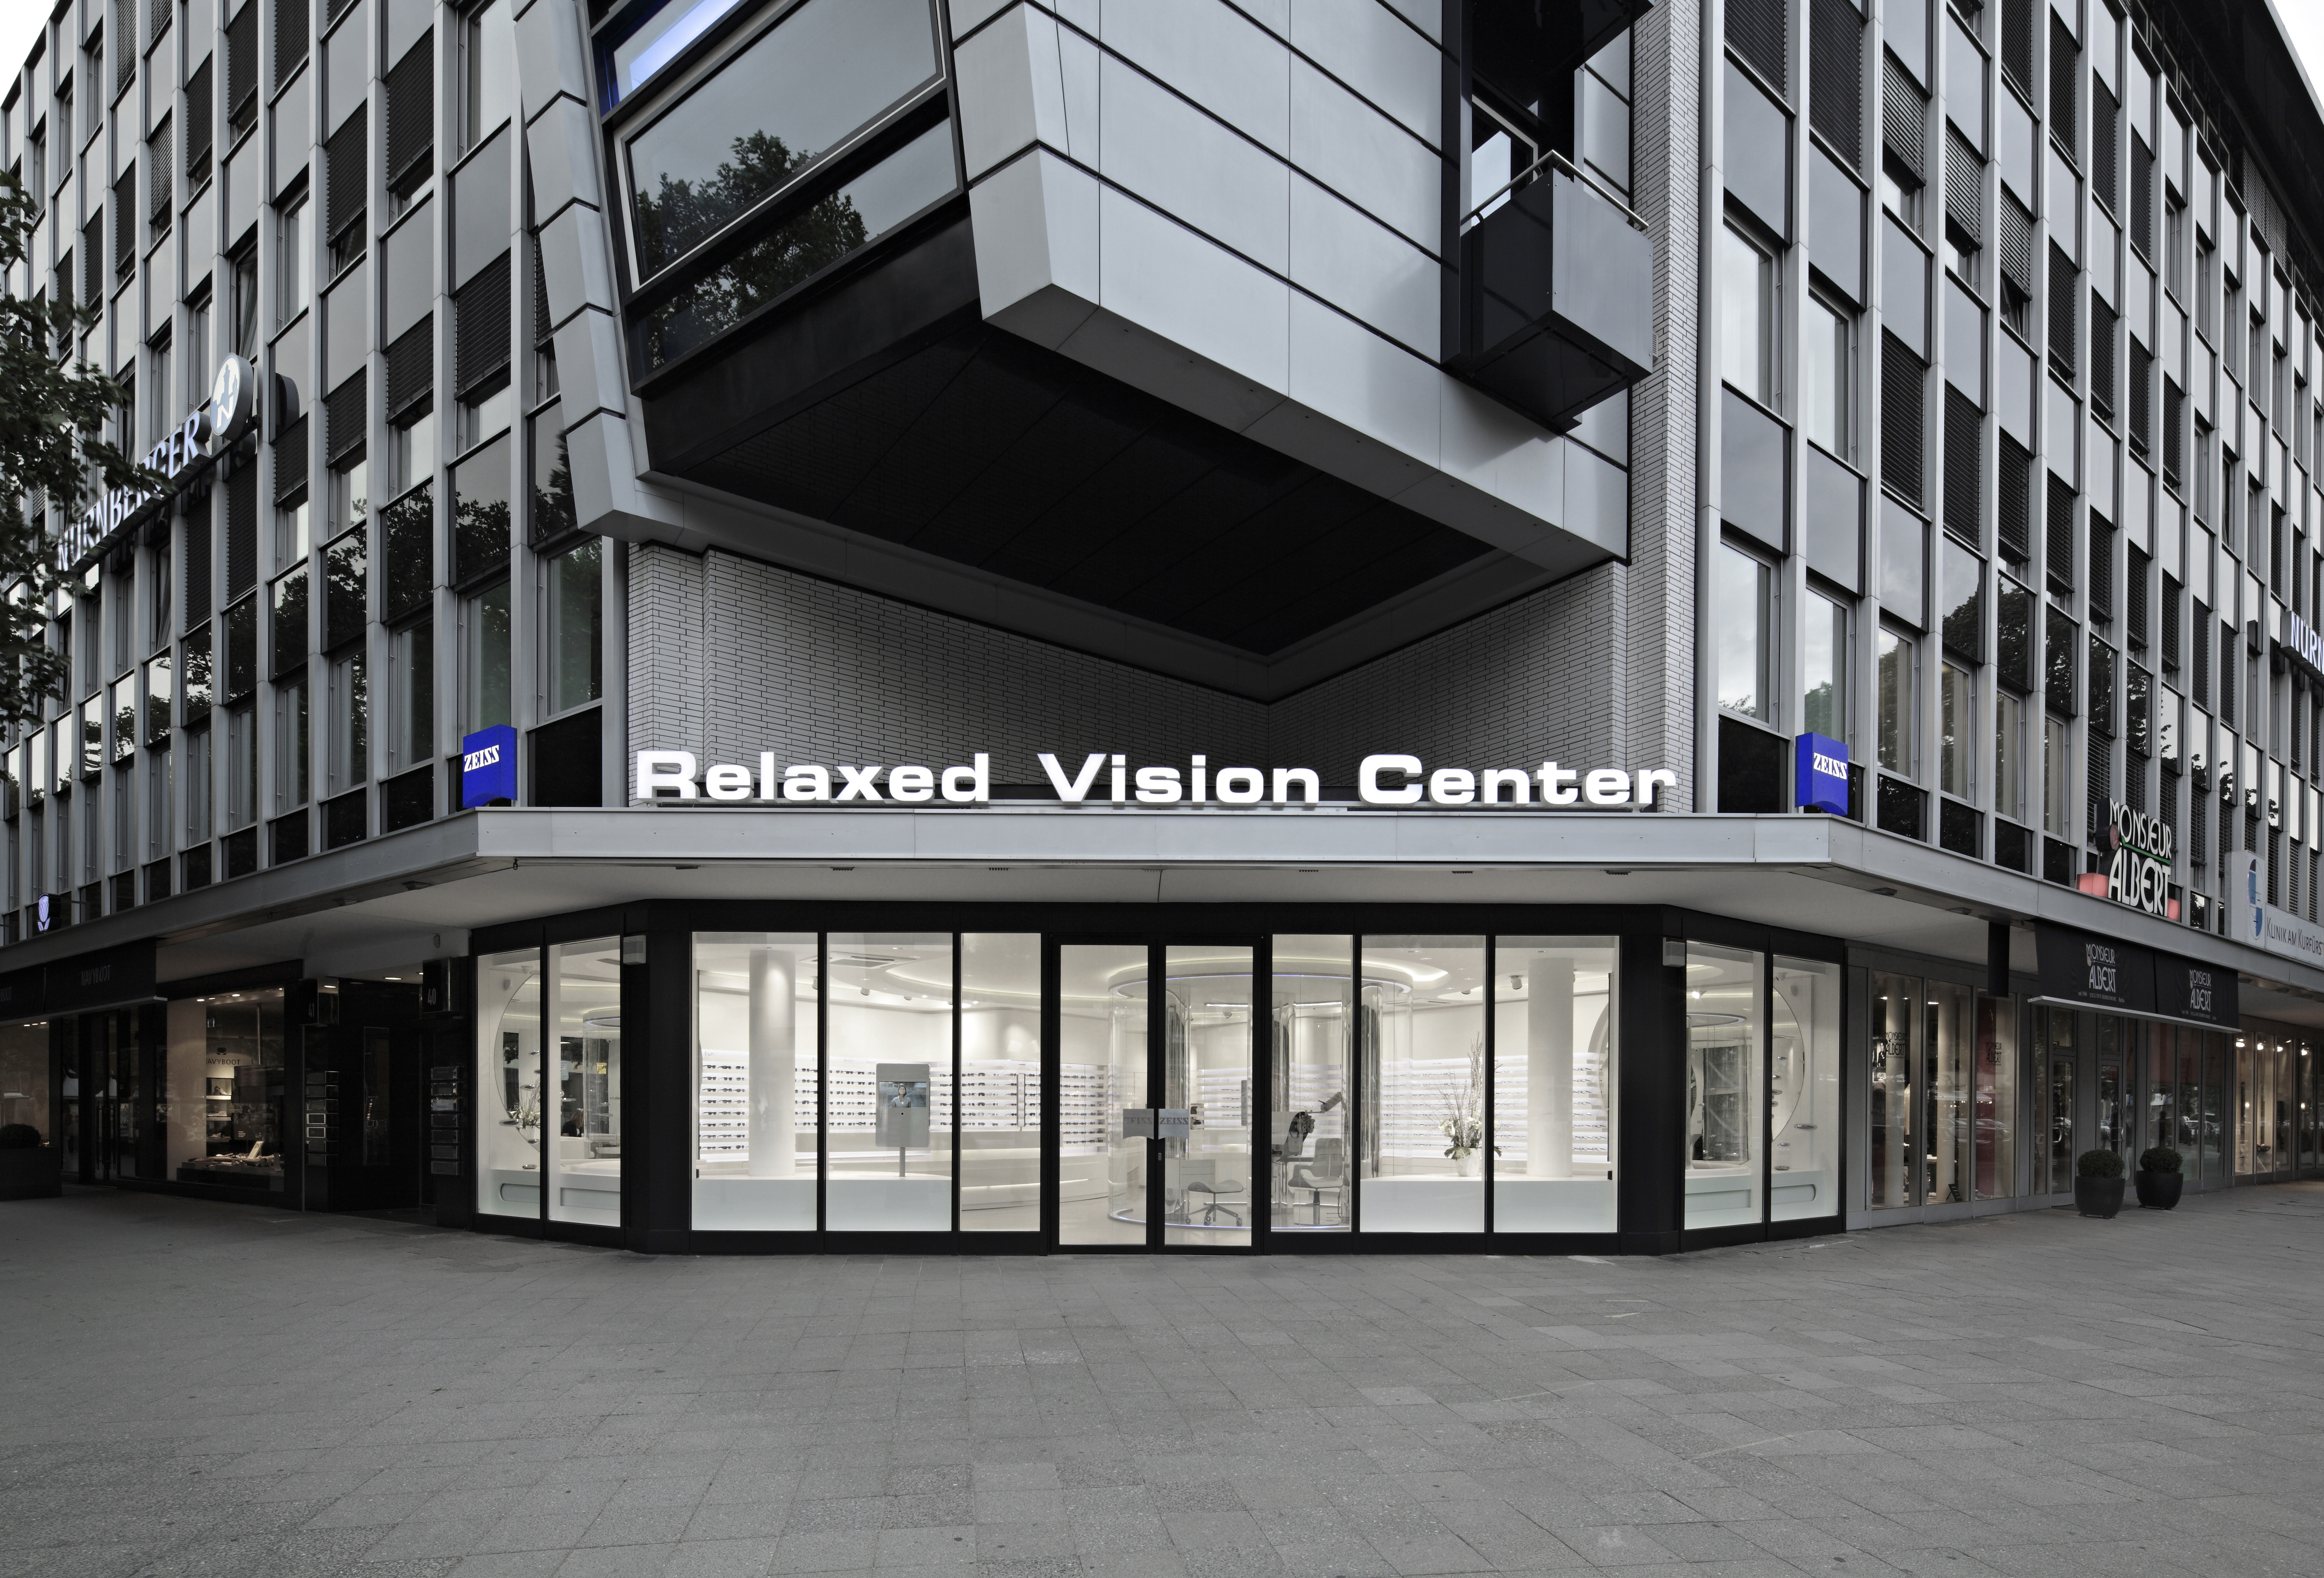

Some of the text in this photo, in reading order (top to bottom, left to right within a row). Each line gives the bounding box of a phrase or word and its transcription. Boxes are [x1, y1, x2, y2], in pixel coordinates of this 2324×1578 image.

[464, 745, 499, 772] ZEISS
[1813, 752, 1847, 780] ZEISS
[637, 750, 1677, 804] Relaxed Vision Center
[2109, 797, 2172, 859] MONSIEUR
[2108, 847, 2172, 917] ALBERT
[2267, 916, 2323, 955] KLINIK AM KURFÜRS
[2086, 943, 2115, 964] MONSIEUR
[81, 965, 111, 987] NAVYBOOT
[2089, 965, 2116, 993] ALBERT
[2189, 969, 2212, 987] MONSIEUR
[427, 988, 437, 1005] 40
[2190, 988, 2212, 1012] ALBERT
[308, 1002, 314, 1018] 41
[1885, 1043, 1905, 1056] ALBERT
